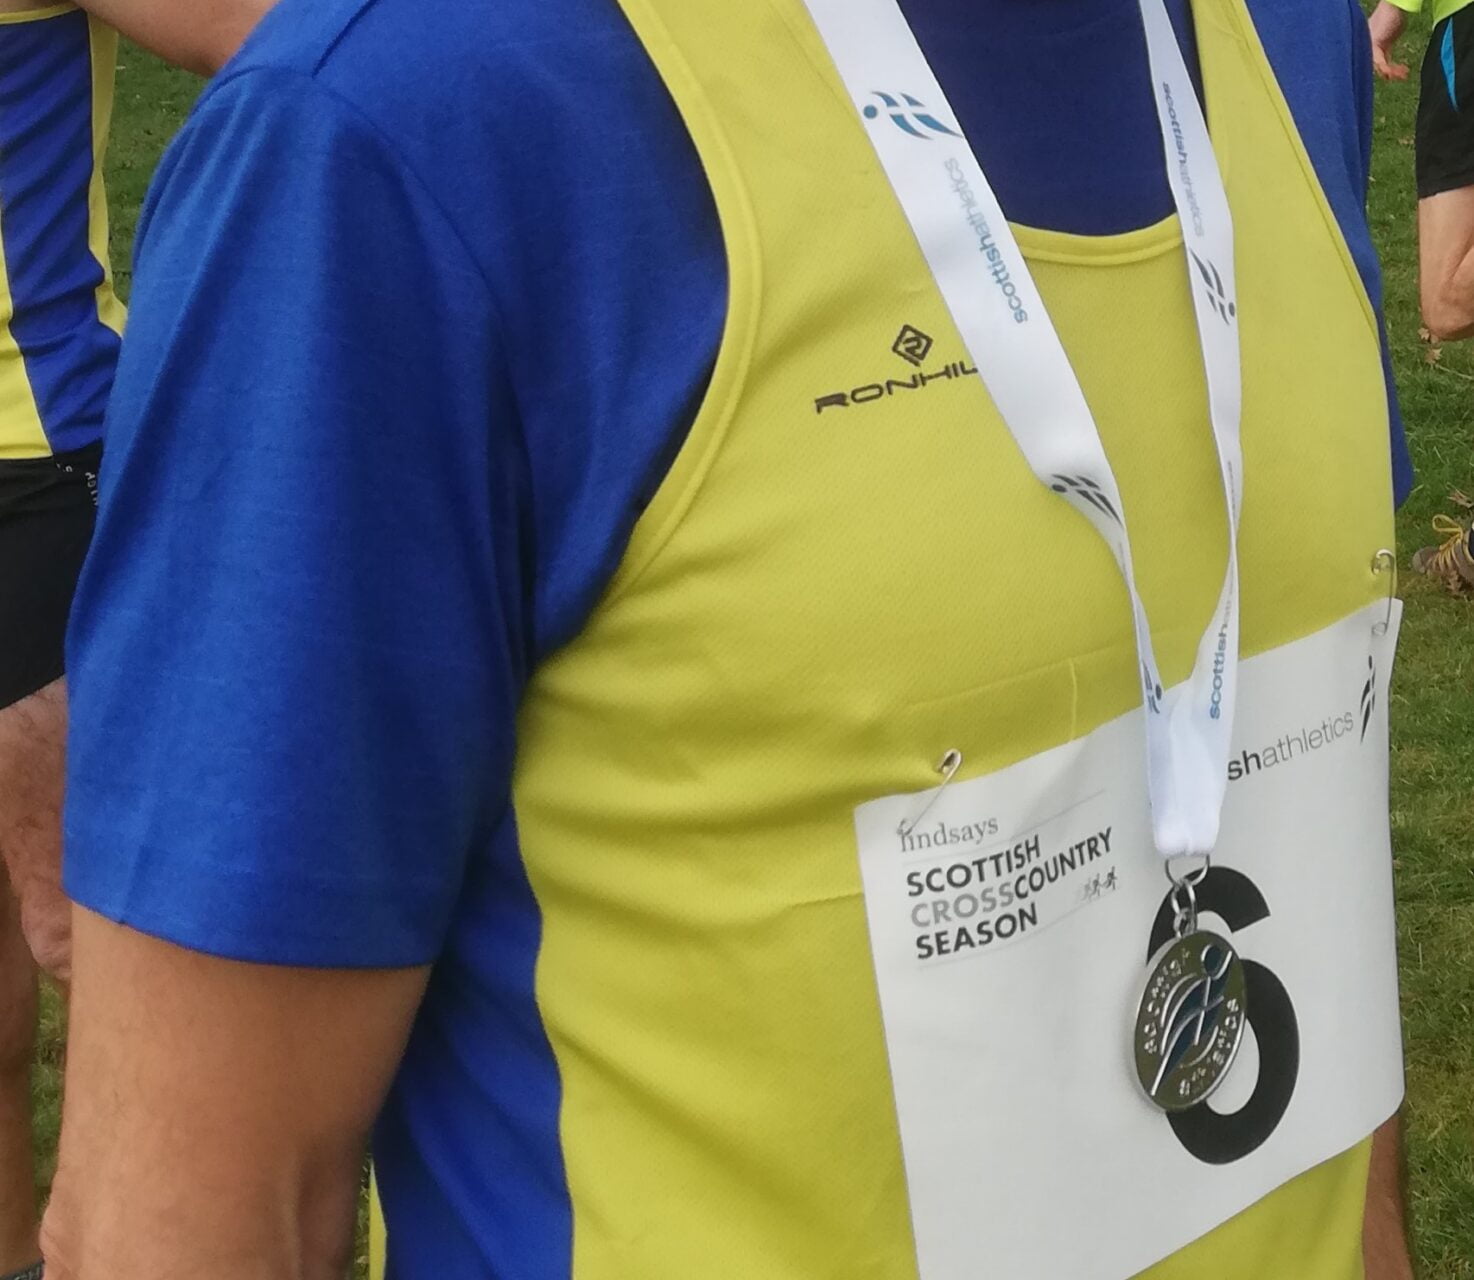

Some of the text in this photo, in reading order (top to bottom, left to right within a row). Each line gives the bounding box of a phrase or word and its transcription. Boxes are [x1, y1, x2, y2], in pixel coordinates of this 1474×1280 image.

[814, 360, 978, 415] RONHIL
[1227, 711, 1355, 781] shathletics
[906, 834, 1041, 897] SCOTTISH
[915, 901, 1038, 960] SEASON
[1147, 866, 1299, 1165] 6
